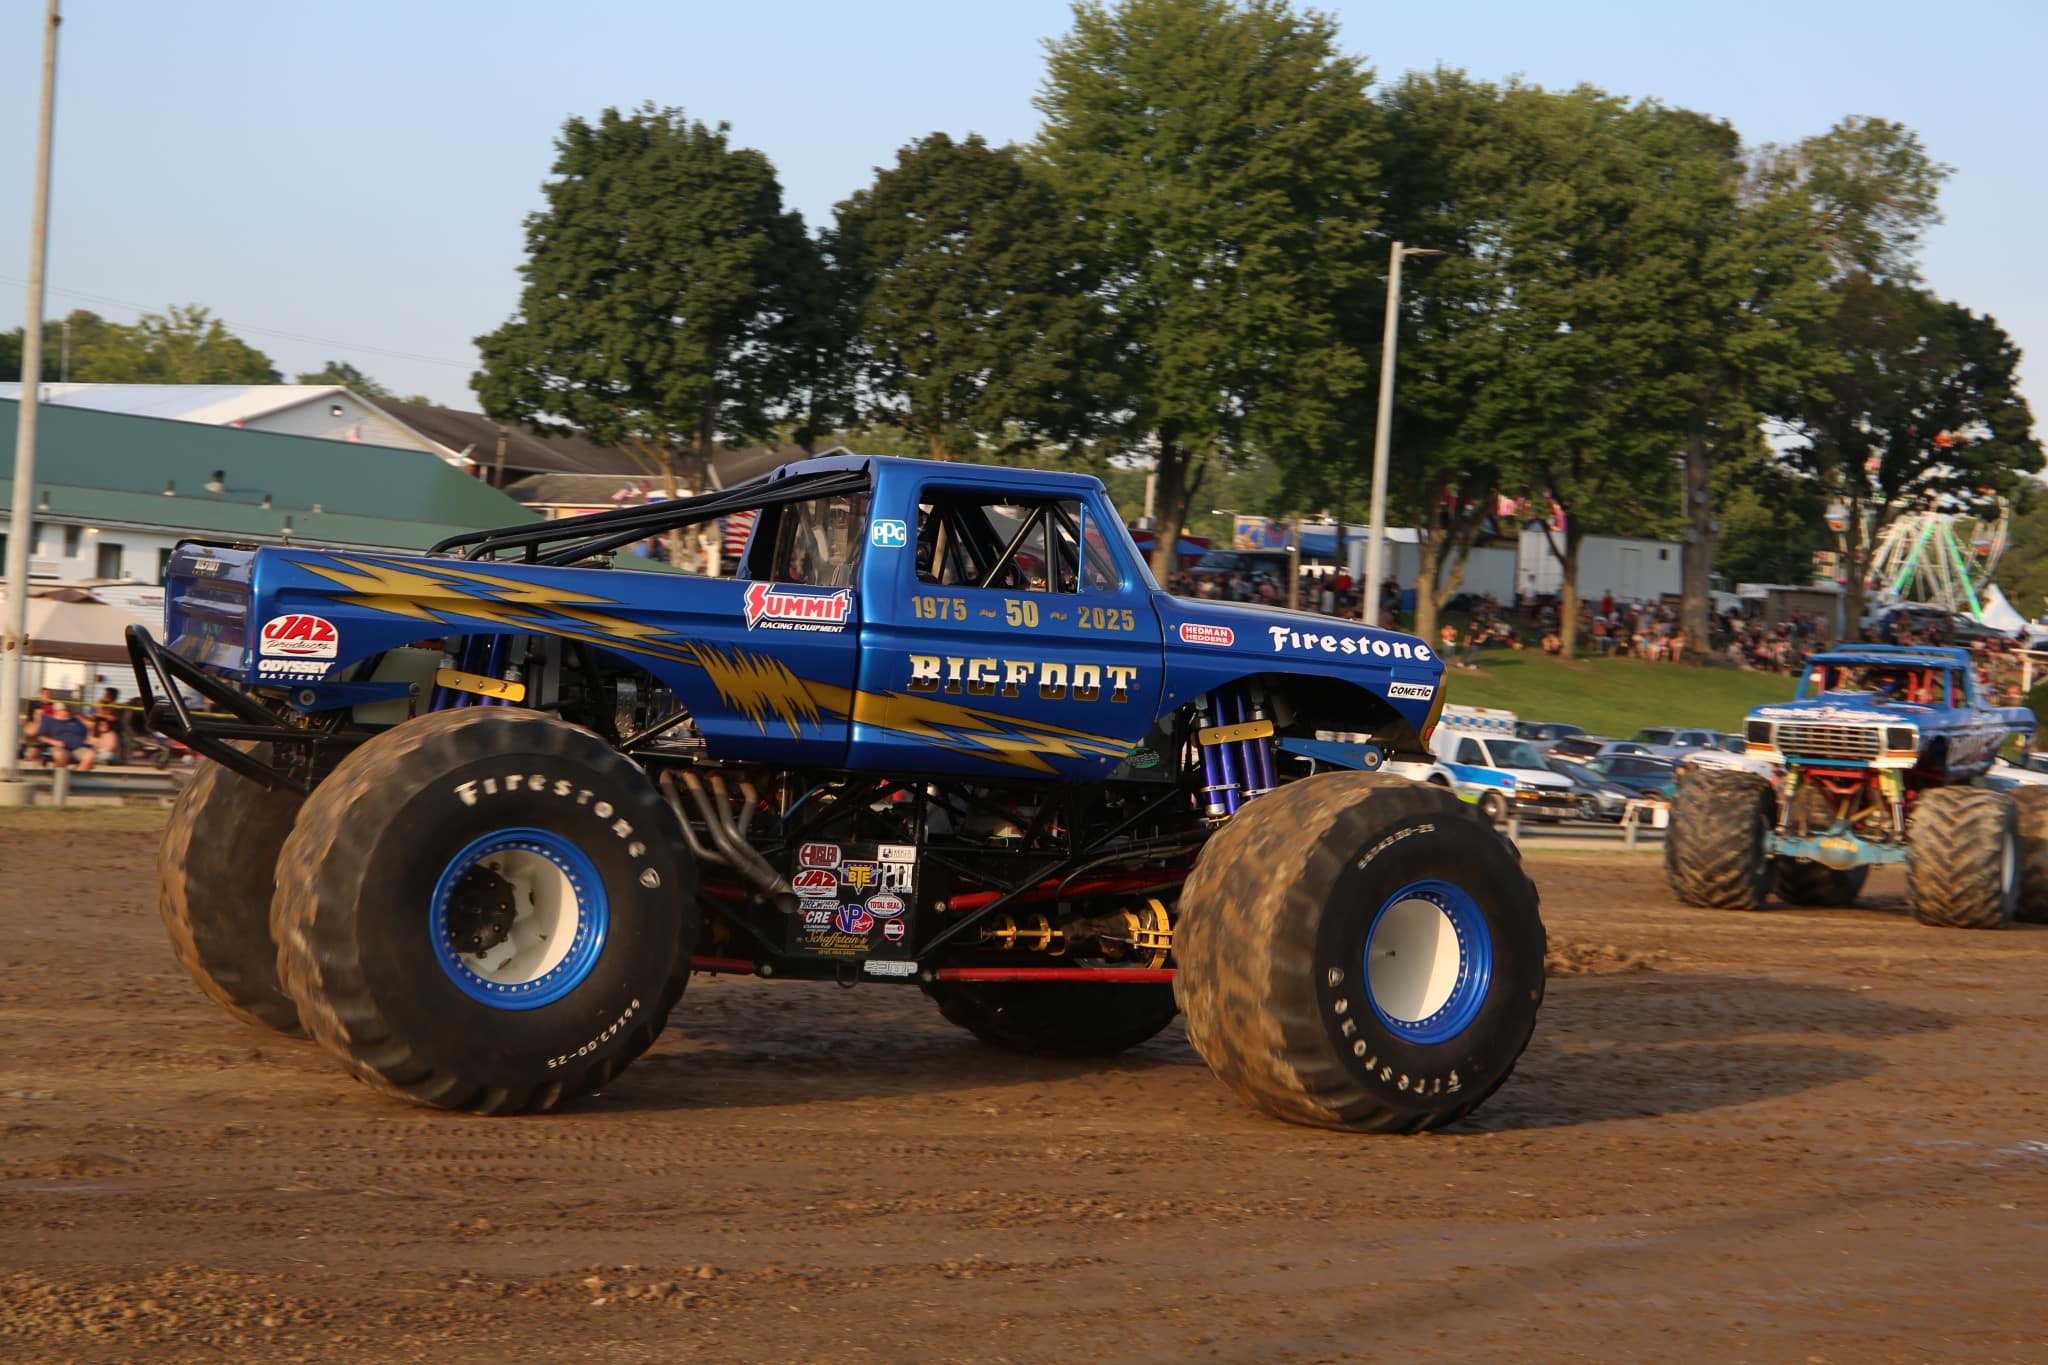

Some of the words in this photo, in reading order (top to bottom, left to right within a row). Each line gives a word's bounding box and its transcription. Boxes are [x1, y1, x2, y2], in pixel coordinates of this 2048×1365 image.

[872, 521, 906, 543] PPG
[911, 595, 968, 622] 1975
[1004, 597, 1040, 628] 50
[1077, 606, 1135, 631] 2025
[264, 615, 336, 642] JAZ
[760, 621, 793, 631] RACING
[793, 622, 845, 633] EQUIPMENT
[1185, 626, 1228, 637] HEDMAN
[1268, 625, 1433, 662] Firestone
[258, 659, 336, 675] ODYSSEY
[259, 672, 325, 681] BATTERY
[906, 653, 1138, 704] BIGFOOT
[1390, 686, 1432, 697] COMETIC
[794, 870, 836, 887] JAZ
[870, 901, 885, 909] TOTAL
[886, 901, 900, 910] SEAL
[805, 910, 832, 924] CRE
[838, 904, 864, 934] VP
